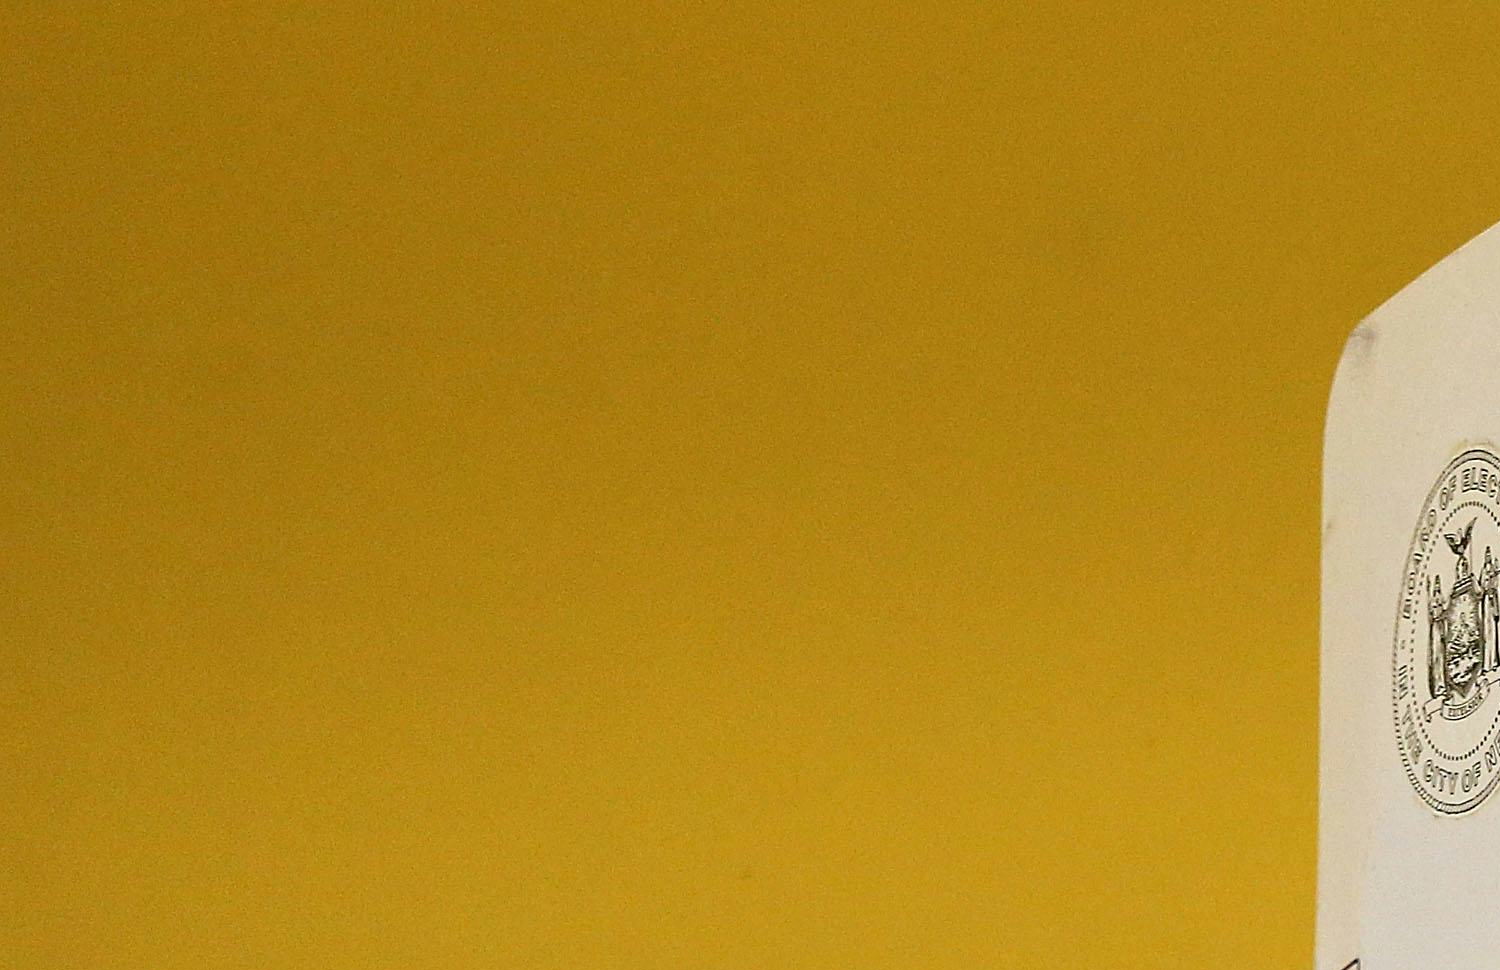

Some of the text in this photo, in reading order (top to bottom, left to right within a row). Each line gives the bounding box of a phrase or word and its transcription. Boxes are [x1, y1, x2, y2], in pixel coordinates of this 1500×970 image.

[1440, 475, 1457, 510] OF
[1423, 760, 1459, 794] CITY
[1461, 761, 1482, 792] OF
